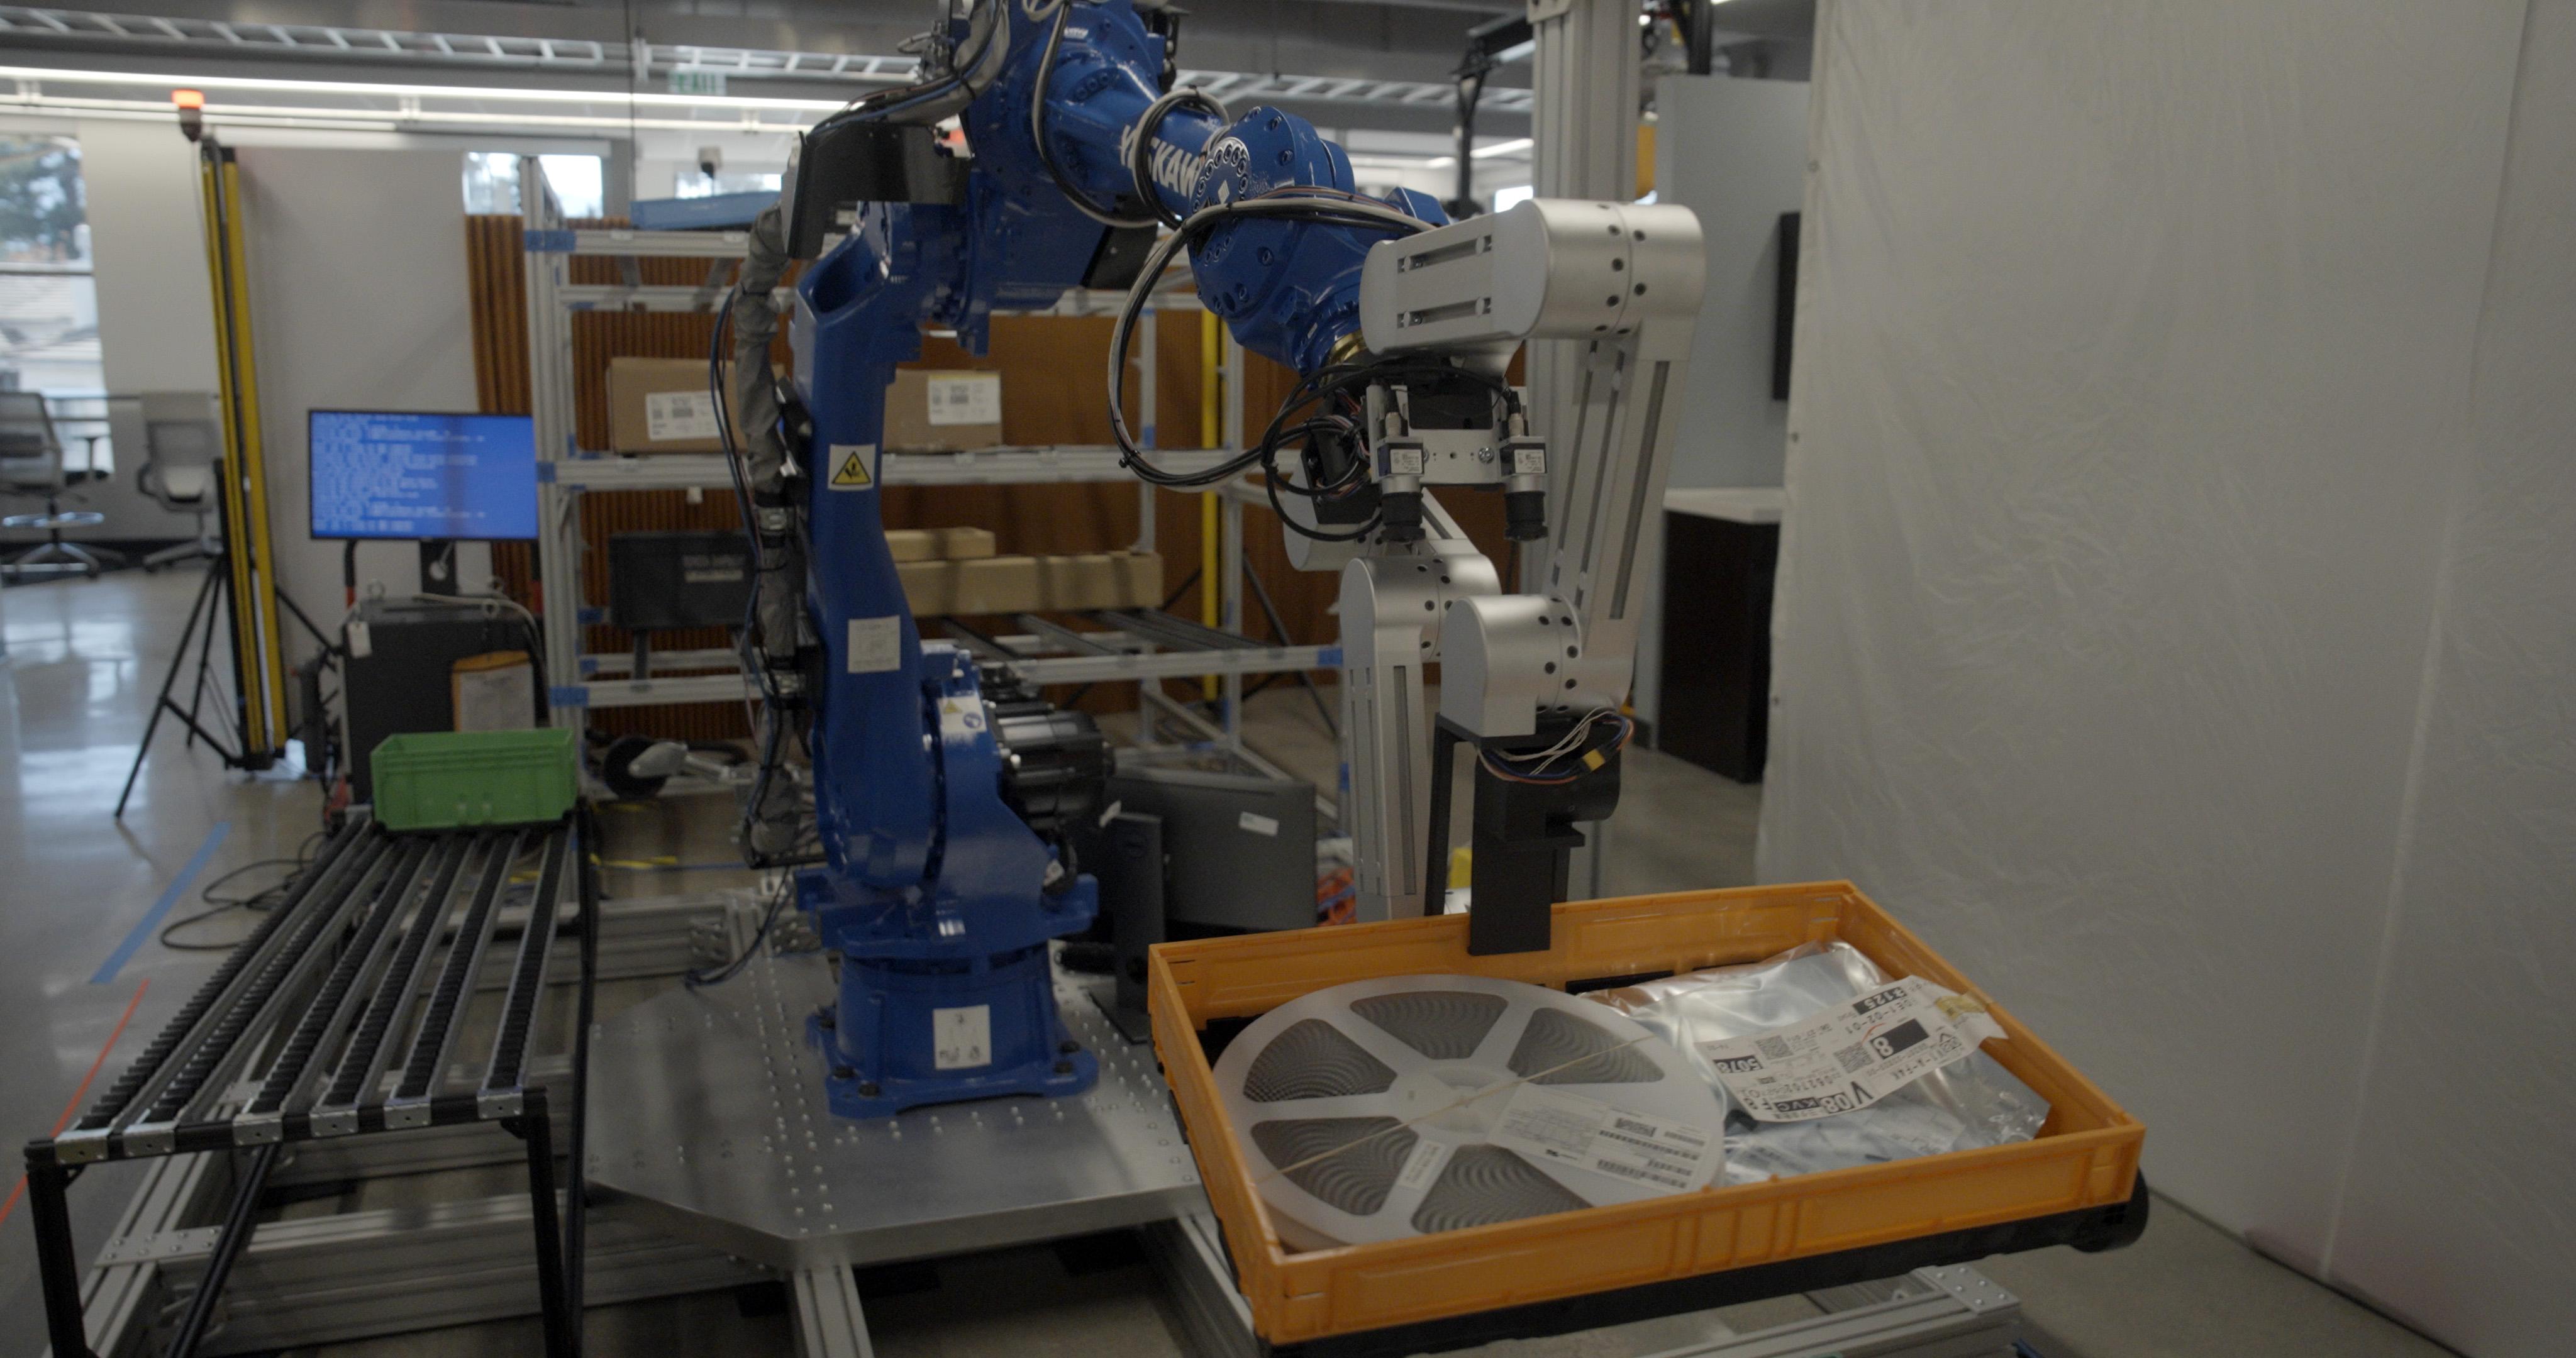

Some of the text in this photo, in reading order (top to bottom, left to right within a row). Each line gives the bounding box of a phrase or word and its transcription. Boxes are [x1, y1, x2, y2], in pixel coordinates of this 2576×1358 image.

[1872, 1037, 1894, 1057] 8
[1851, 1080, 1874, 1105] V
[1821, 1093, 1852, 1113] 08
